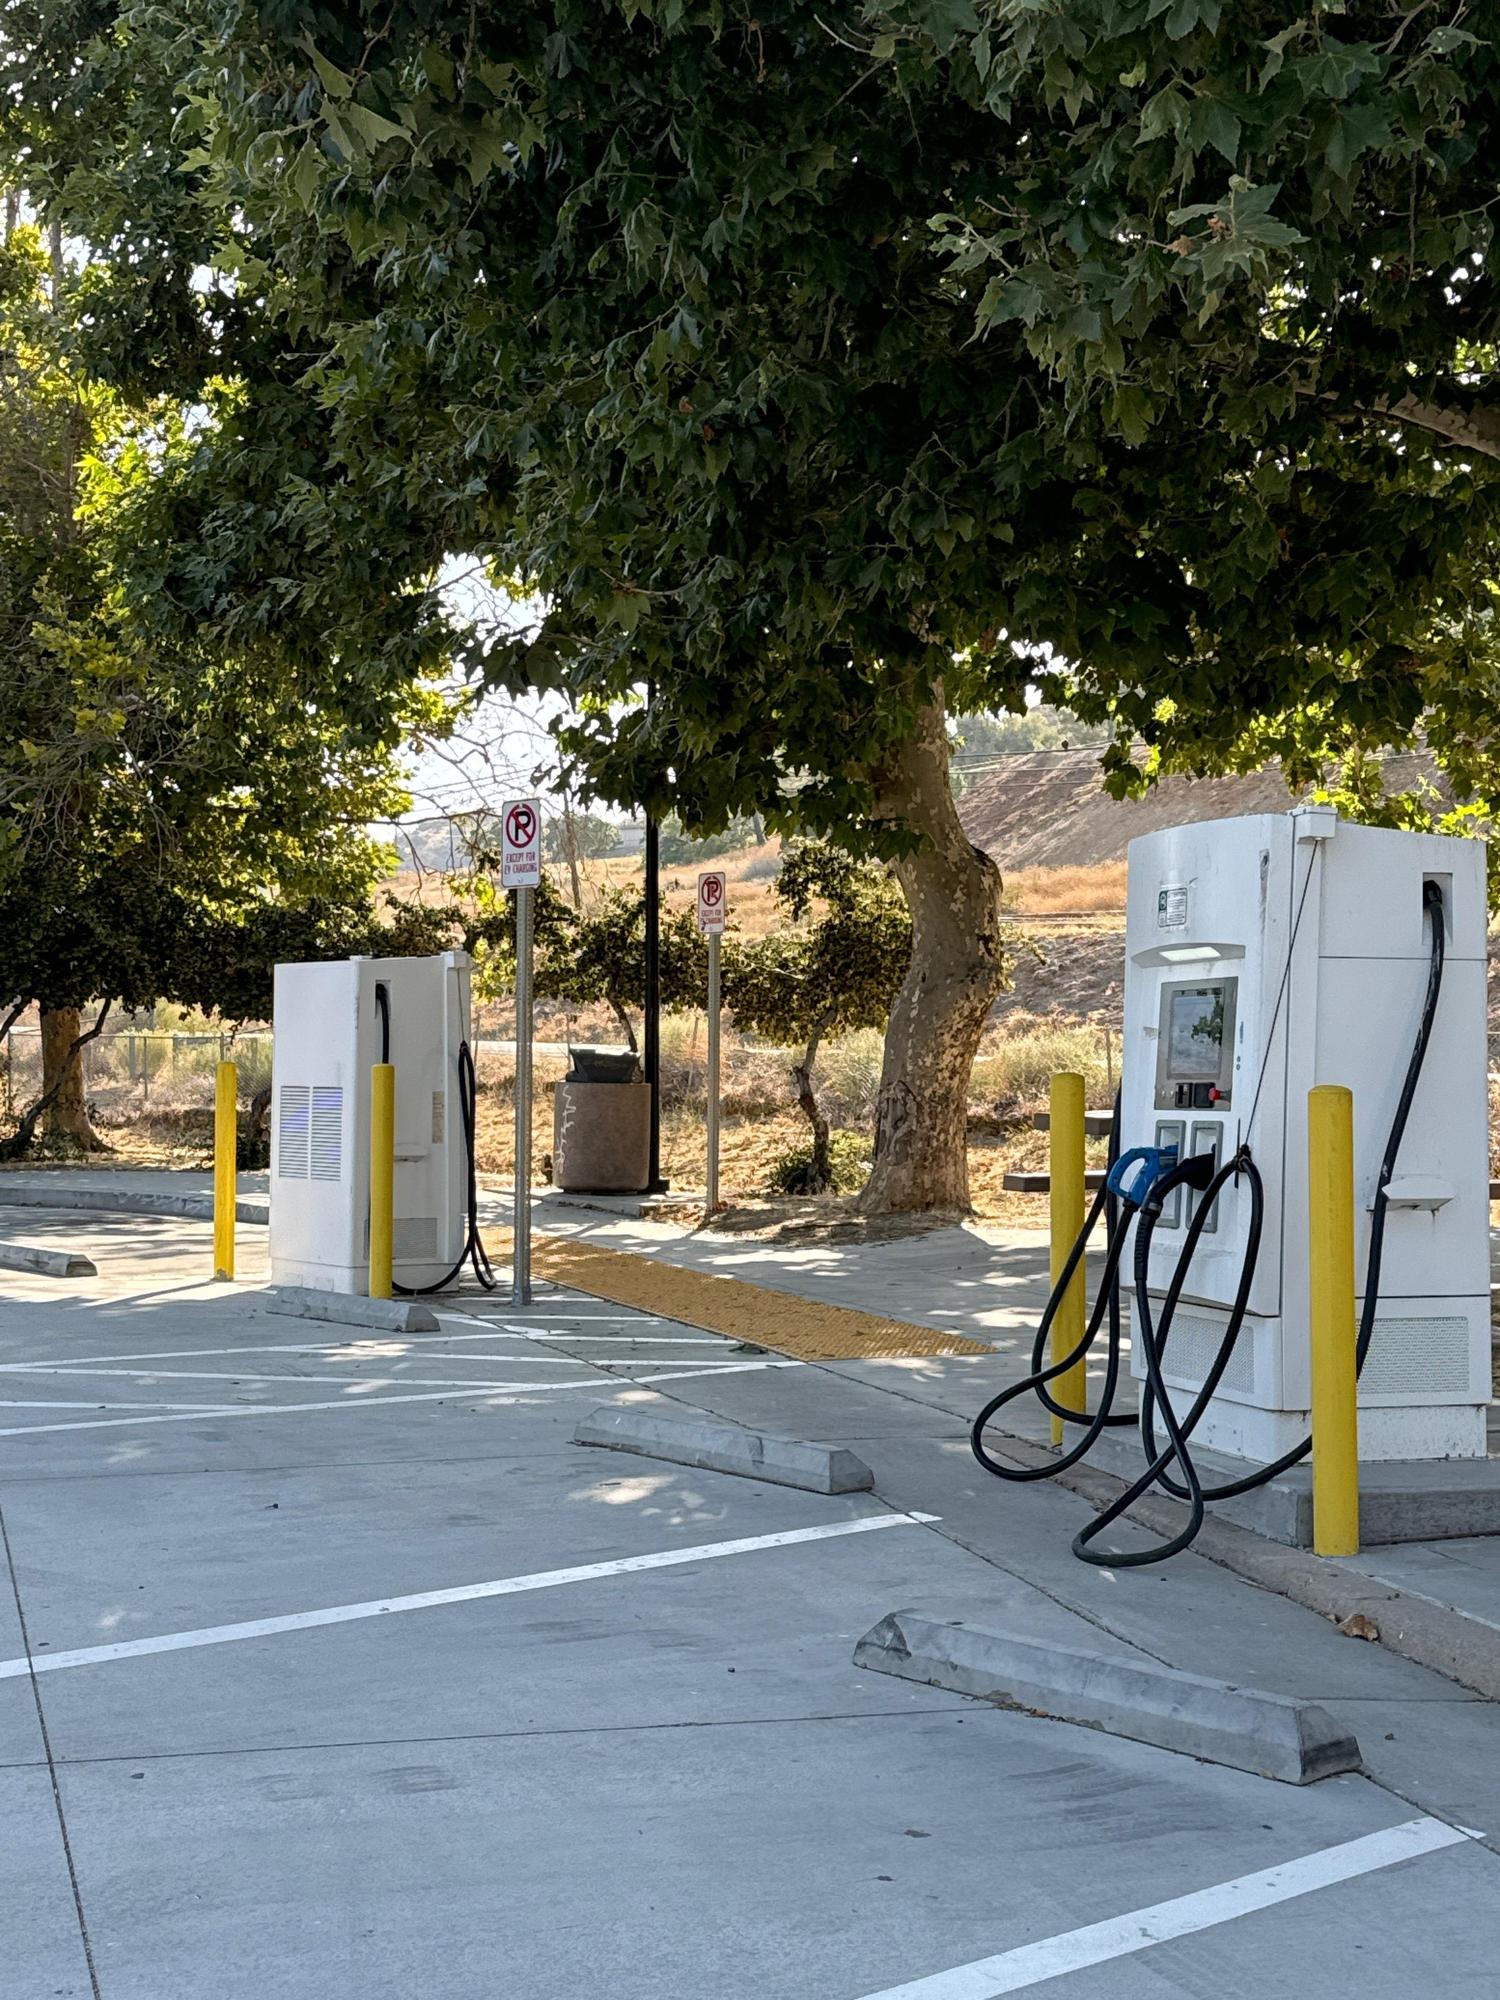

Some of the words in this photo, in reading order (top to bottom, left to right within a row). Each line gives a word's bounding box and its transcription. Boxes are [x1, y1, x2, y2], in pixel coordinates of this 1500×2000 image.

[514, 810, 531, 841] P
[506, 852, 524, 863] EXCEPT
[526, 851, 535, 862] FOR
